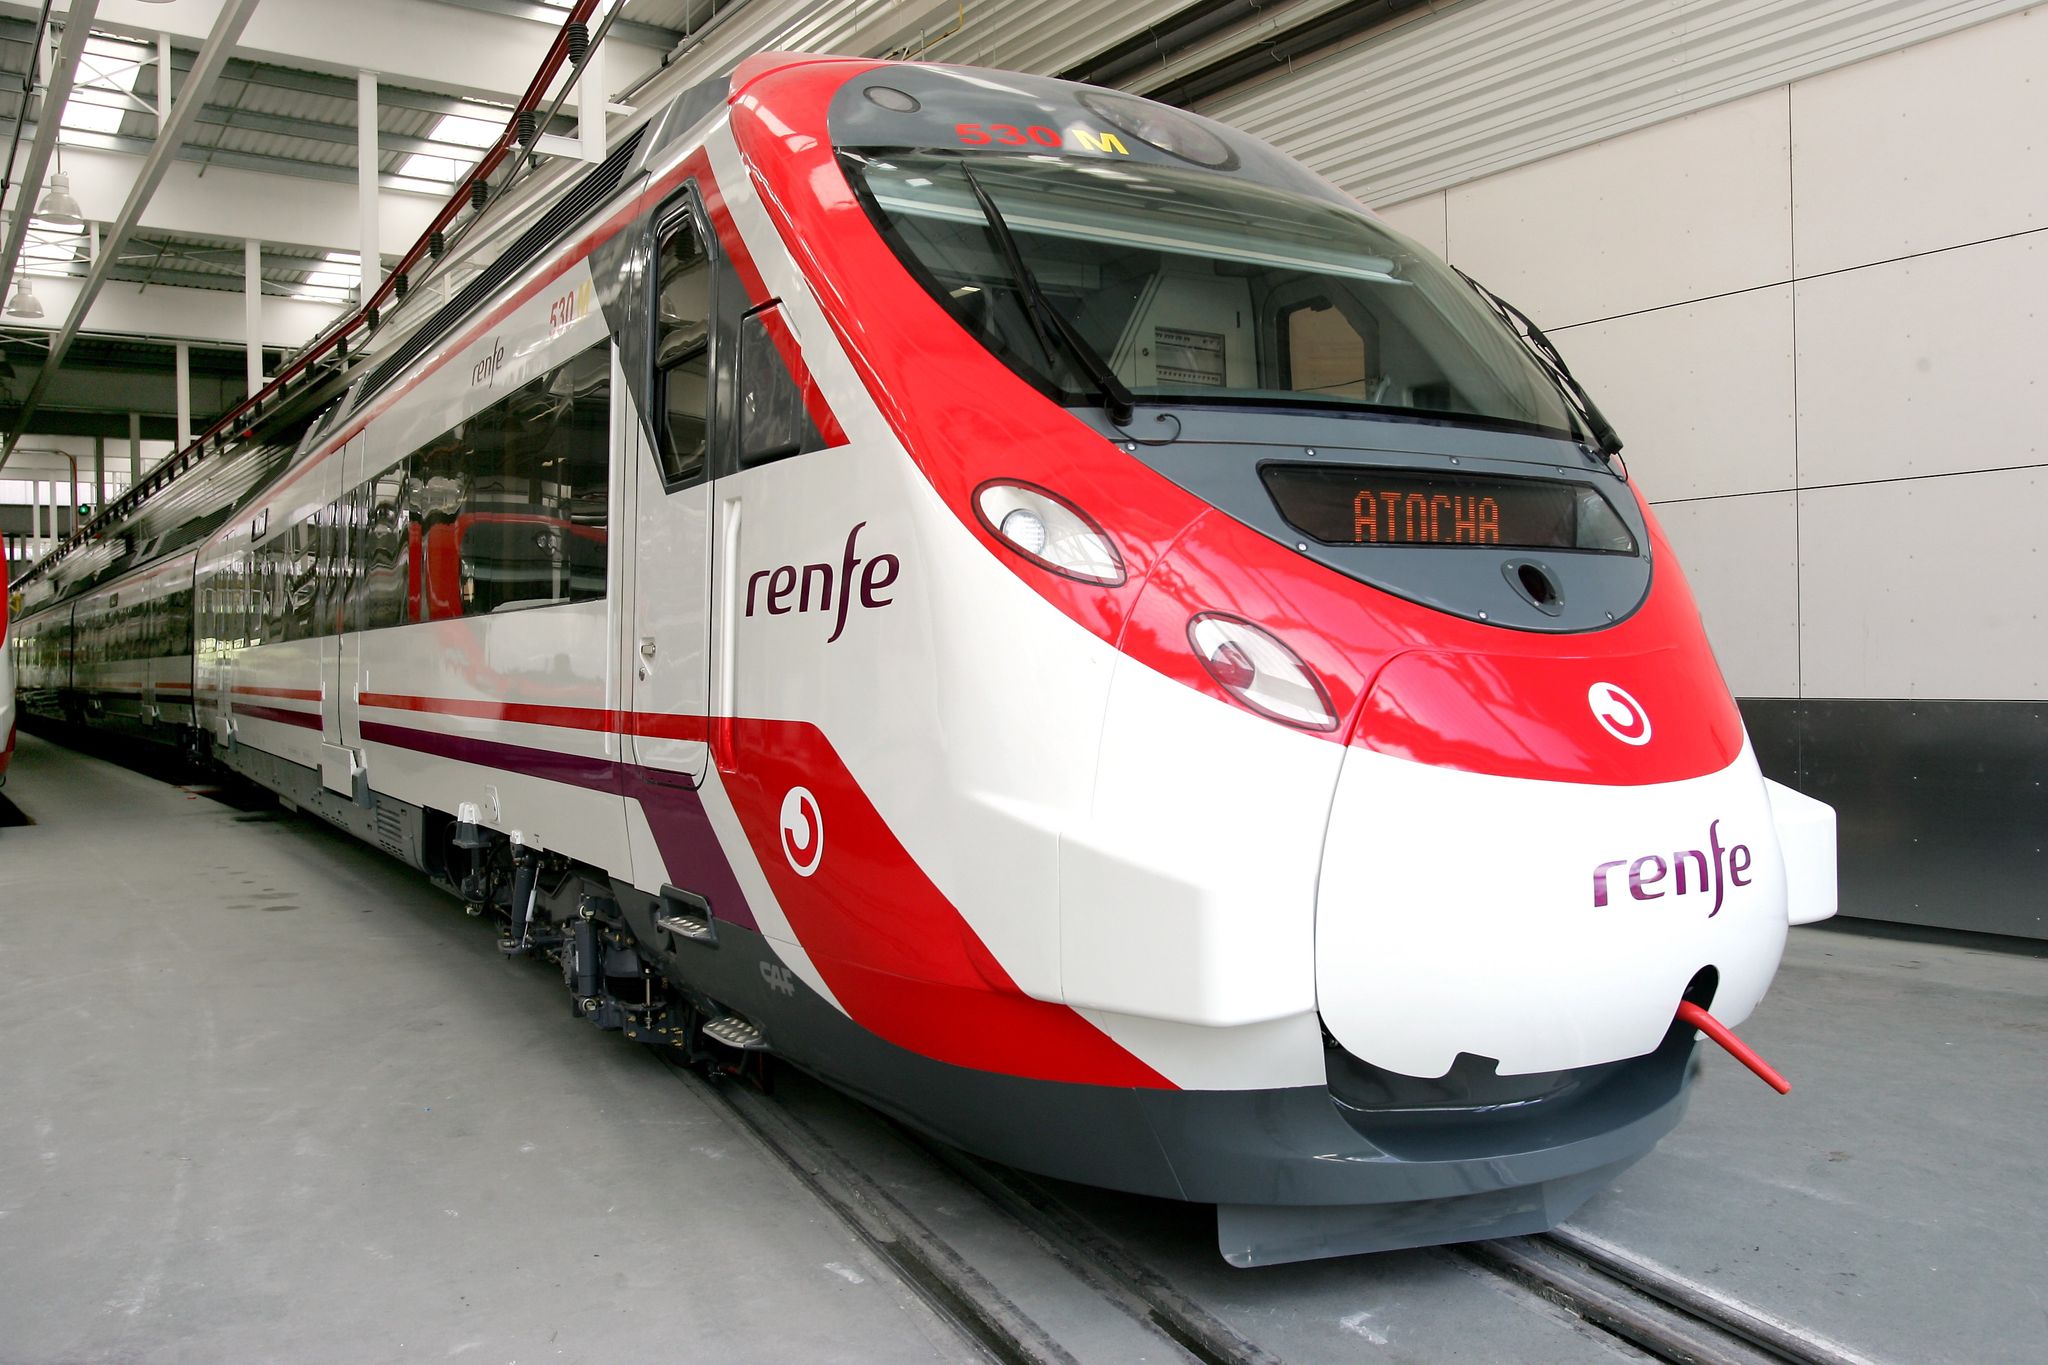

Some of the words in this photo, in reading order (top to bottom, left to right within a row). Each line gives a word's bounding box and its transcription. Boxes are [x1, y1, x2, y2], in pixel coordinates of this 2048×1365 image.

[955, 123, 1064, 148] 530
[1071, 129, 1130, 155] M
[549, 290, 575, 336] 530
[577, 278, 592, 317] M
[472, 335, 504, 389] renfe
[1354, 490, 1499, 543] ATOCHA
[745, 521, 900, 643] renfe
[1593, 819, 1752, 918] renfe
[760, 961, 795, 997] CAF
